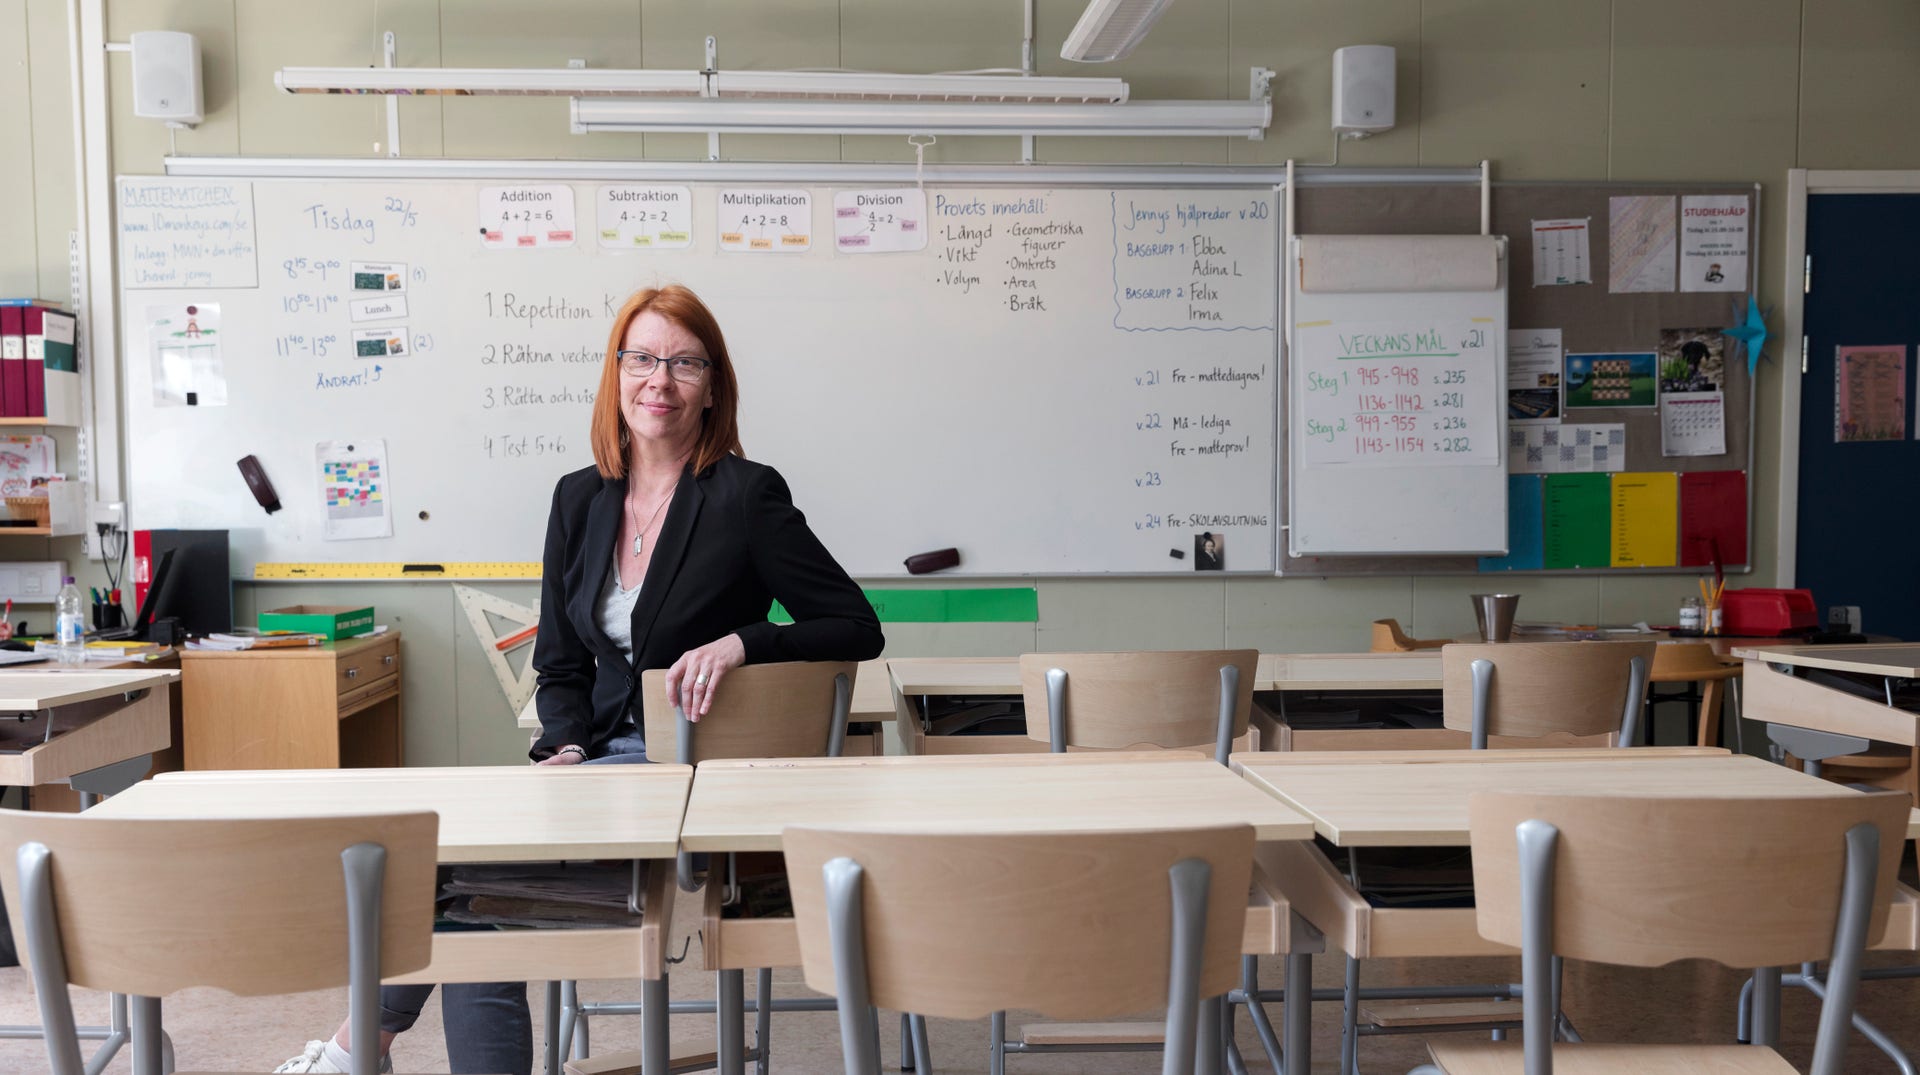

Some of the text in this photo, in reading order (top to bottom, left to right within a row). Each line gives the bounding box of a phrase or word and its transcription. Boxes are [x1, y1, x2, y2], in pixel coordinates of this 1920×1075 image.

[125, 186, 233, 203] MATTEMATCHEN
[501, 190, 552, 202] Addition
[609, 189, 679, 202] Subtraktion
[723, 193, 806, 207] Multiplikation
[857, 194, 903, 206] Division
[935, 194, 986, 216] Provets
[1684, 205, 1746, 217] STUDIEHJÄLP
[304, 204, 375, 244] Tisdag
[502, 211, 509, 221] 4
[524, 210, 531, 221] 2
[545, 210, 553, 221] 6
[620, 211, 627, 221] 4
[639, 211, 647, 222] 2
[661, 211, 668, 222] 2
[742, 215, 749, 225] 4
[759, 215, 766, 226] 2
[780, 215, 788, 226] 8
[869, 211, 875, 220] 4
[887, 214, 893, 224] 2
[1124, 201, 1170, 234] Jennys
[1176, 202, 1231, 228] hjälpredor
[869, 222, 876, 232] 2
[1011, 219, 1084, 237] Geometriska
[946, 246, 978, 263] Vikt
[1021, 237, 1066, 259] figurer
[1127, 242, 1175, 258] BASGRUPP
[1192, 234, 1227, 258] Ebba
[1009, 255, 1056, 271] Omkrets
[1191, 259, 1243, 277] Adina L
[944, 269, 980, 294] Volym
[1008, 275, 1037, 290] Area
[1125, 286, 1171, 300] BASGRUPP
[1189, 280, 1218, 302] Felix
[364, 304, 392, 315] Lunch
[504, 292, 593, 329] Repetition
[1009, 294, 1047, 312] Bråk
[1188, 303, 1223, 321] Irma
[413, 333, 434, 353] (2)
[1338, 332, 1412, 355] VECKANS
[1415, 328, 1448, 351] MÅL
[503, 343, 554, 365] Räkna
[315, 367, 369, 391] ÄNDRAT!
[1172, 368, 1186, 383] Fre
[1307, 370, 1338, 396] Steg
[1343, 371, 1349, 385] 1
[503, 385, 545, 406] Rätta
[550, 386, 574, 404] och
[1173, 416, 1189, 430] Må
[1200, 414, 1231, 435] lediga
[1307, 418, 1335, 443] Steg
[1336, 418, 1348, 432] 2
[501, 435, 528, 457] Test
[1171, 440, 1186, 457] Fre
[1198, 435, 1249, 459] matteprov!
[1189, 513, 1268, 527] SKOLAVSLUTNING
